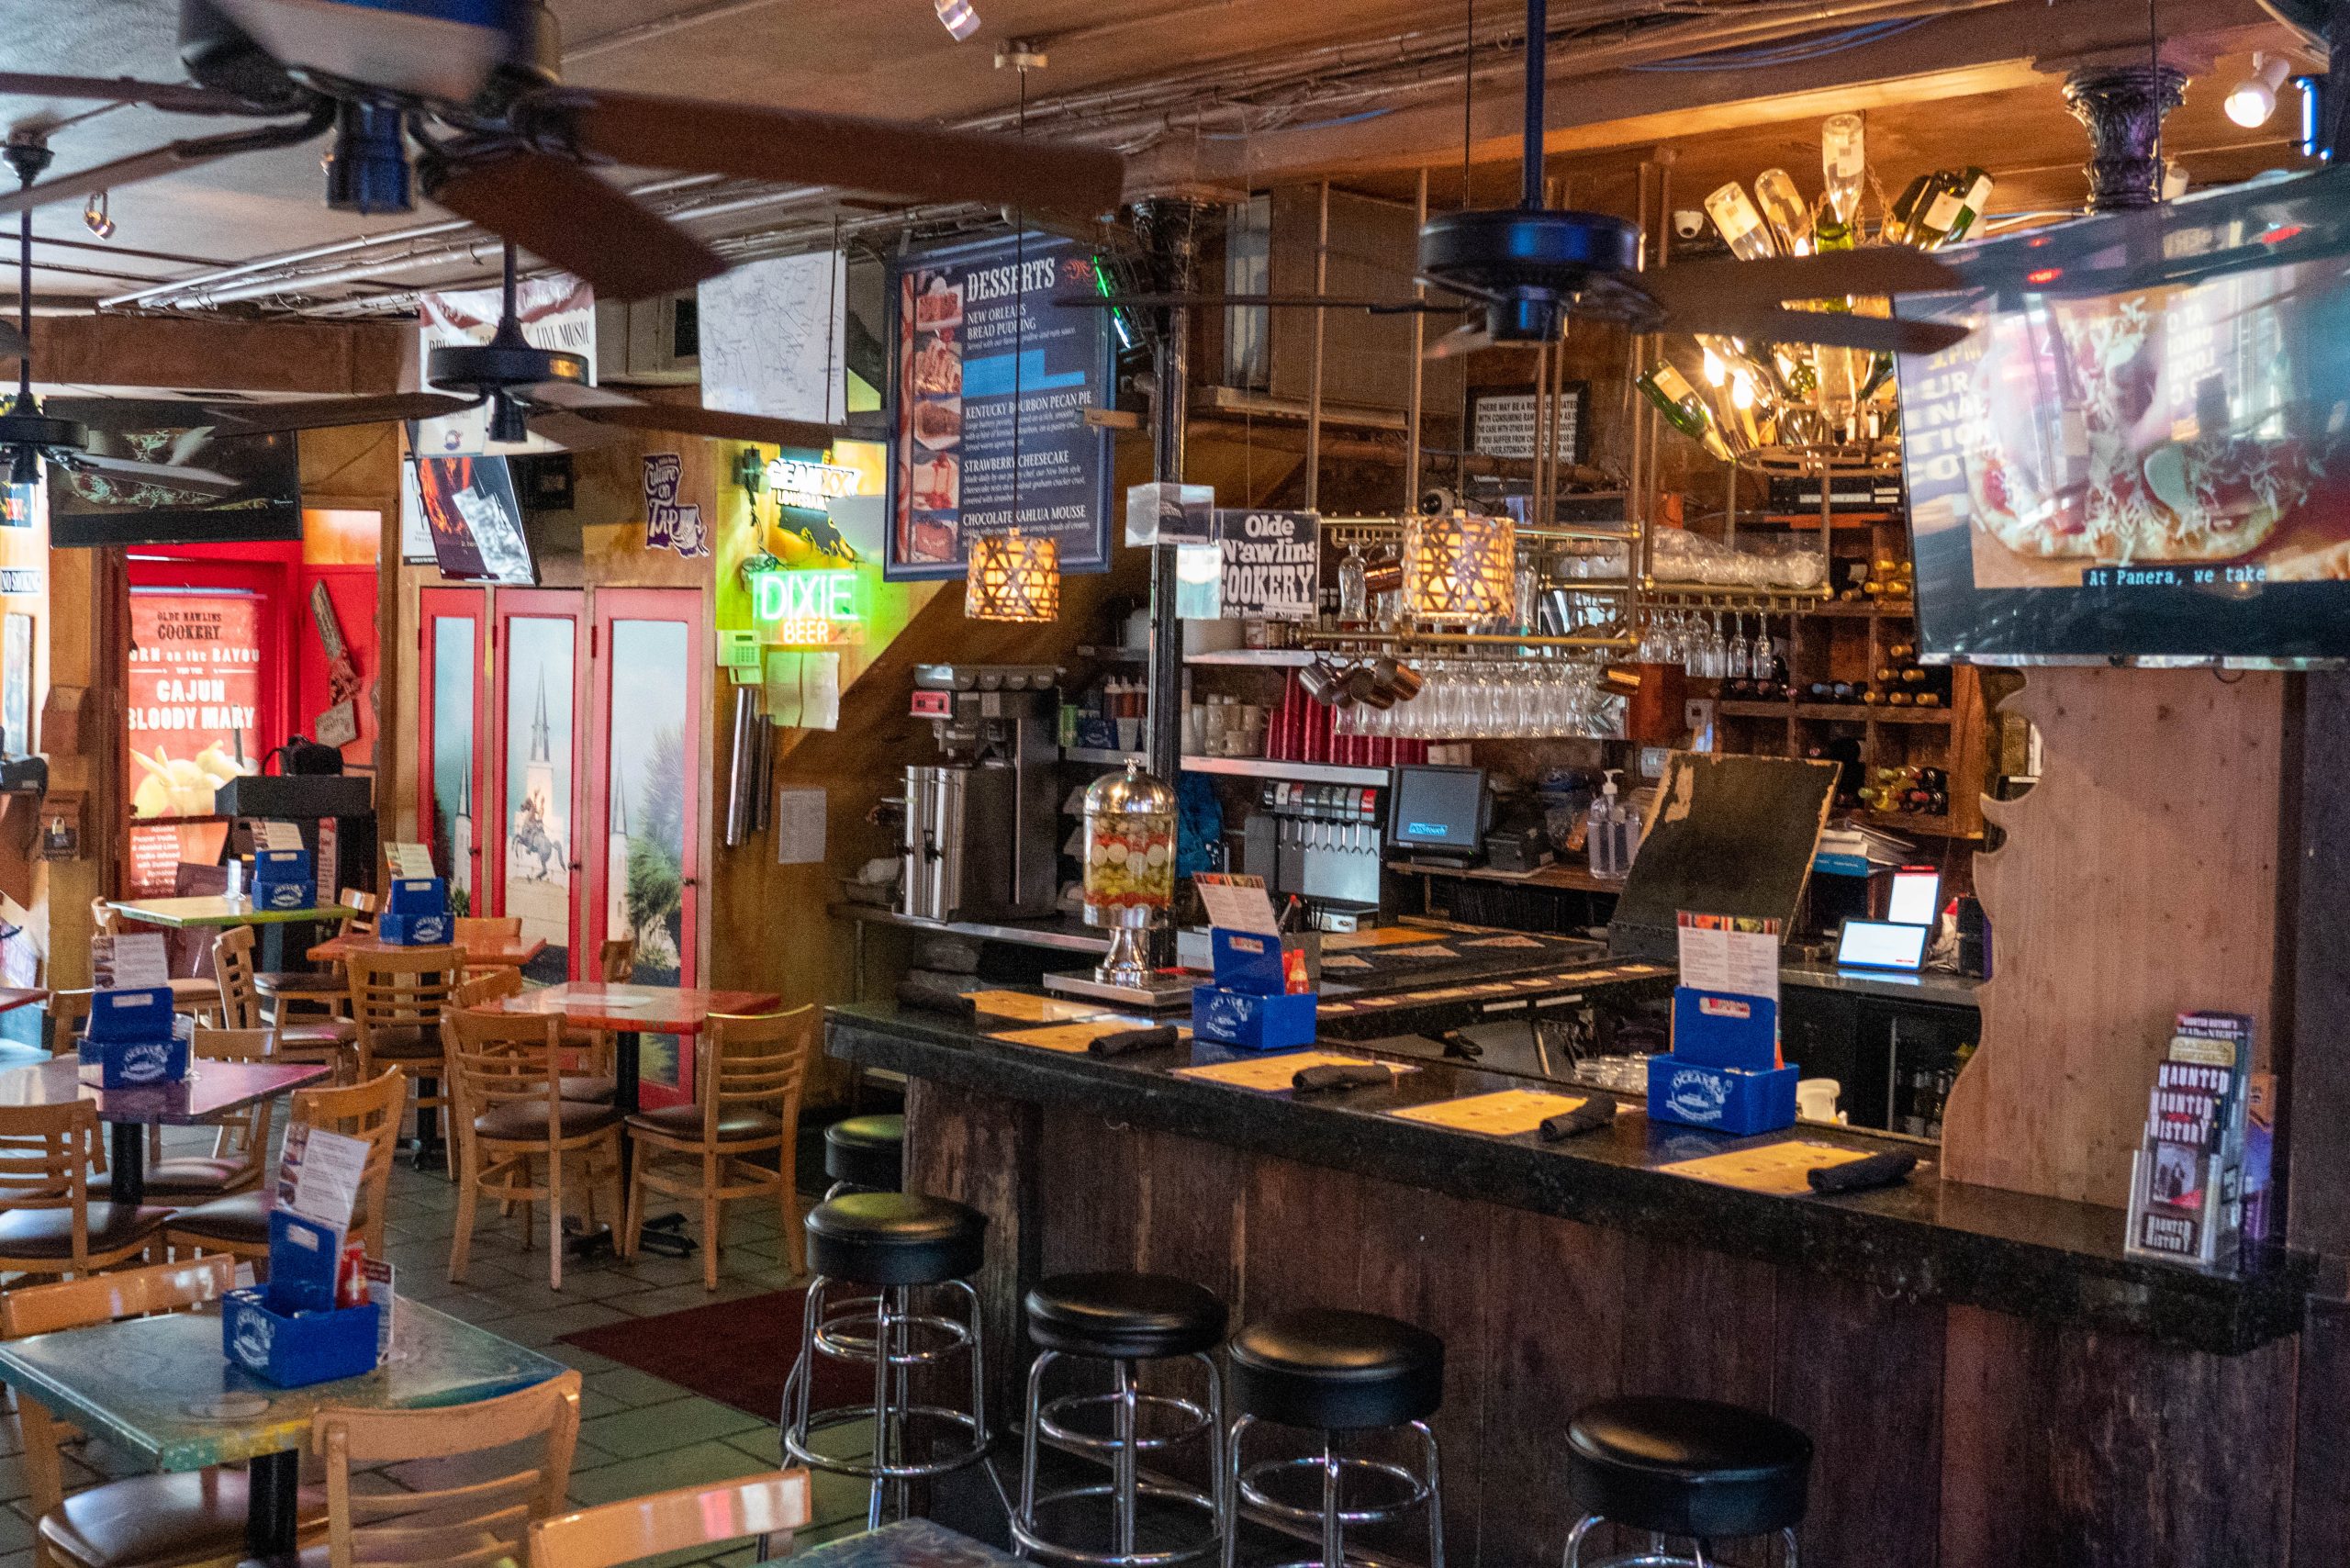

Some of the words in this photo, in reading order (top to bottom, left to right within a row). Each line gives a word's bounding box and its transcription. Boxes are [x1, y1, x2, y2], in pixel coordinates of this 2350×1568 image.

[967, 257, 1055, 303] DESSERTS
[968, 310, 987, 325] NEW
[968, 324, 996, 341] BREAD
[966, 402, 1007, 420] KENTUCKY
[1049, 393, 1077, 409] PECAN
[1079, 390, 1092, 405] PIE
[1512, 402, 1519, 411] BE
[965, 456, 1015, 473] STRAWBERRY
[1017, 450, 1069, 468] CHEESECAKE
[657, 484, 671, 499] on
[962, 510, 1013, 526] CHOCOLATE
[1051, 504, 1087, 521] MOUSSE
[1245, 514, 1295, 538] Olde
[2089, 571, 2108, 587] At
[2116, 569, 2183, 587] Panera,
[2194, 569, 2214, 584] we
[2225, 565, 2266, 582] take
[761, 574, 859, 621] DIXIE
[157, 611, 180, 622] OLDE
[158, 624, 221, 640] COOKERY
[783, 621, 829, 644] BEER
[166, 651, 181, 662] on
[185, 649, 207, 662] the
[212, 648, 260, 662] BAYOU
[157, 679, 225, 702] CAJUN
[129, 706, 197, 731] BLOODY
[201, 706, 255, 730] MARY
[2158, 1063, 2229, 1095] HAUNTED
[2150, 1088, 2212, 1120] HAUNTED
[2150, 1114, 2210, 1144] HISTORY
[2147, 1215, 2191, 1237] HAUNTED
[2146, 1231, 2189, 1251] HISTORY
